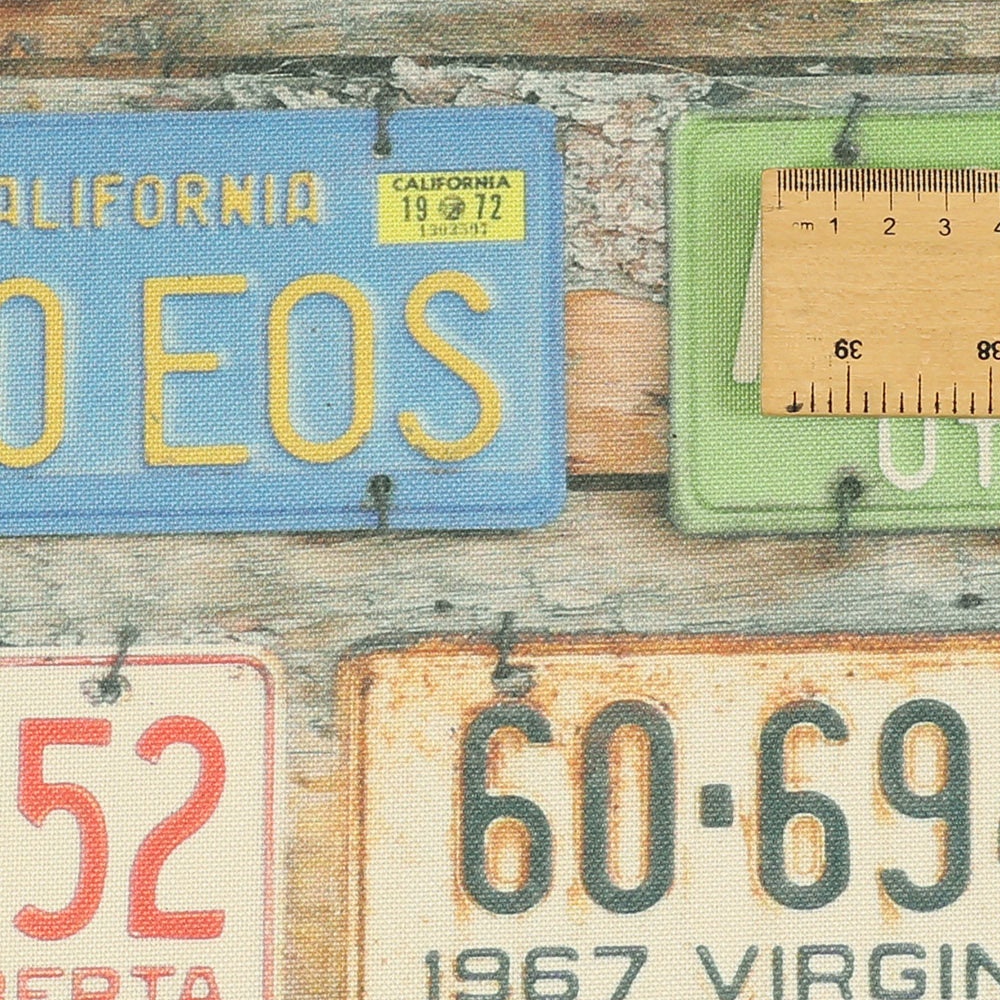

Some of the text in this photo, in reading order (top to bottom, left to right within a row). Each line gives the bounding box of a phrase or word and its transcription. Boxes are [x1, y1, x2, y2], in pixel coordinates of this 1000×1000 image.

[392, 175, 512, 191] CALIFORNIA
[402, 193, 503, 222] 19 72
[830, 218, 838, 235] 1
[883, 217, 896, 236] 2
[939, 218, 951, 237] 3
[835, 338, 863, 360] 39
[142, 270, 501, 467] EOS
[13, 714, 227, 941] 52
[424, 944, 648, 1000] 1967
